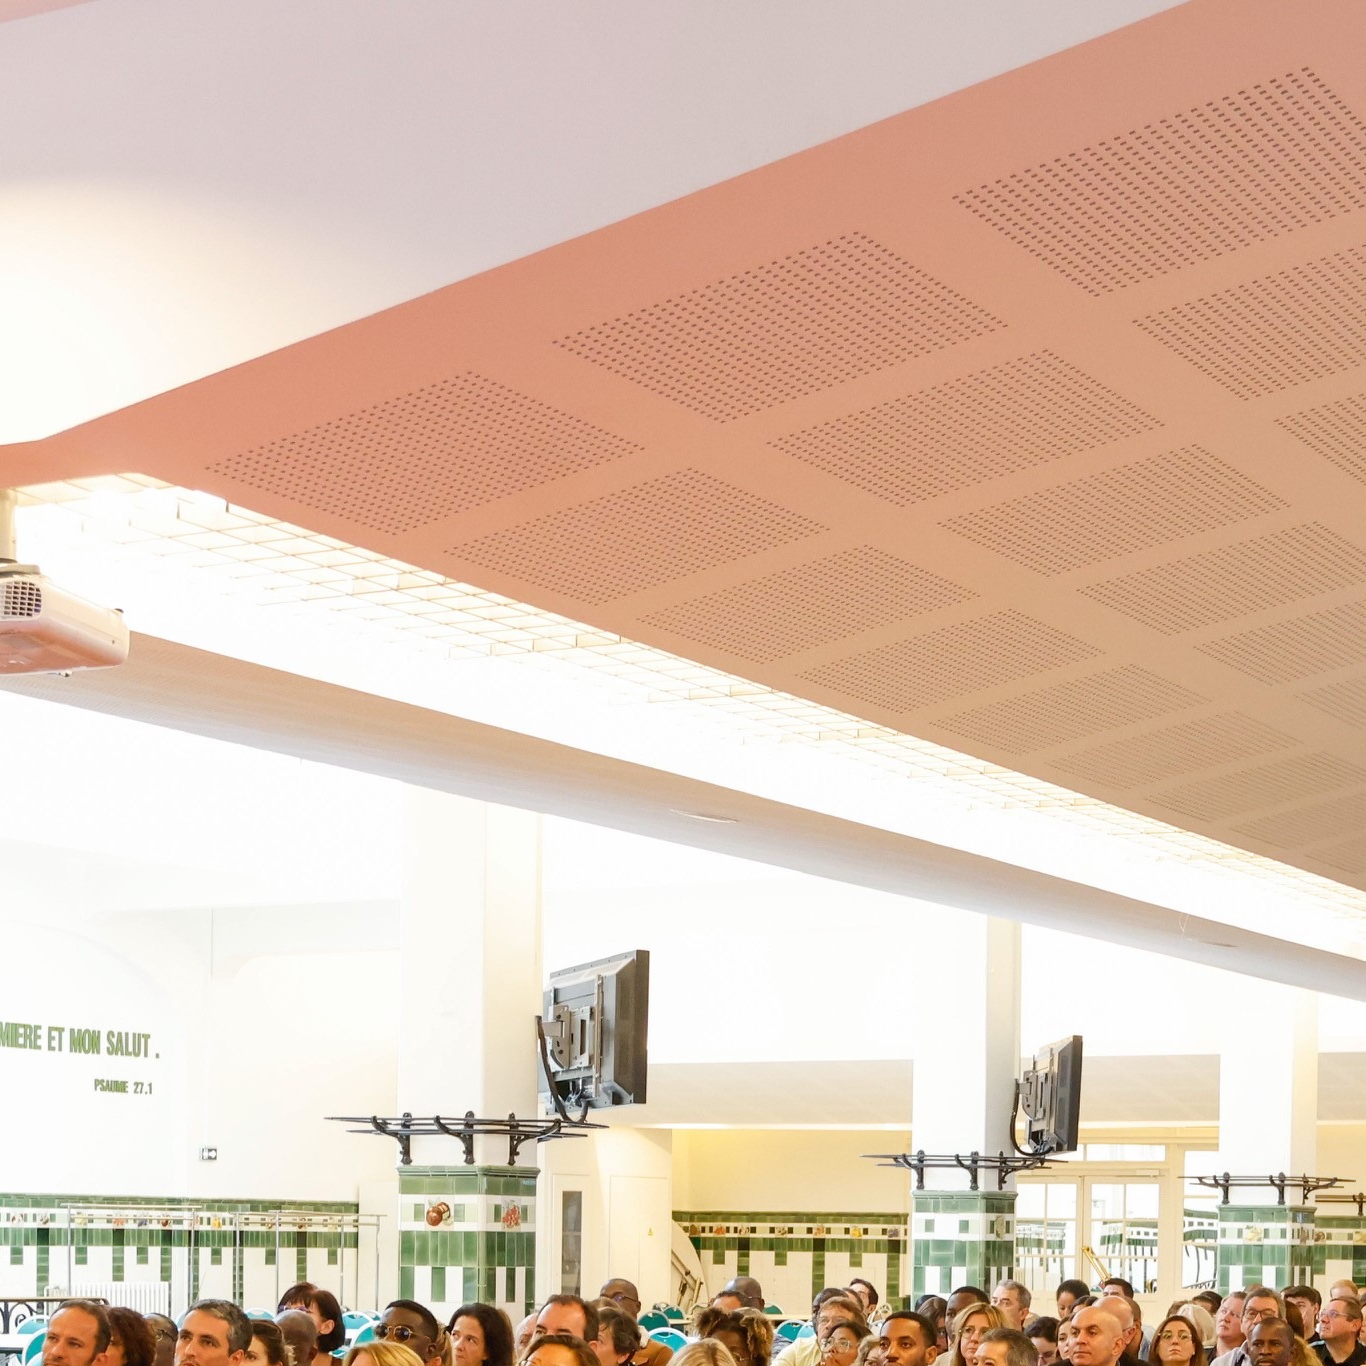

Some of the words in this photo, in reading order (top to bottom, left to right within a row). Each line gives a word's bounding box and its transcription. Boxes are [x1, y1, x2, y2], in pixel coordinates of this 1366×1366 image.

[48, 1026, 65, 1052] ET
[69, 1028, 101, 1055] MON
[94, 1078, 129, 1094] PSAUME
[133, 1081, 153, 1095] 27.1
